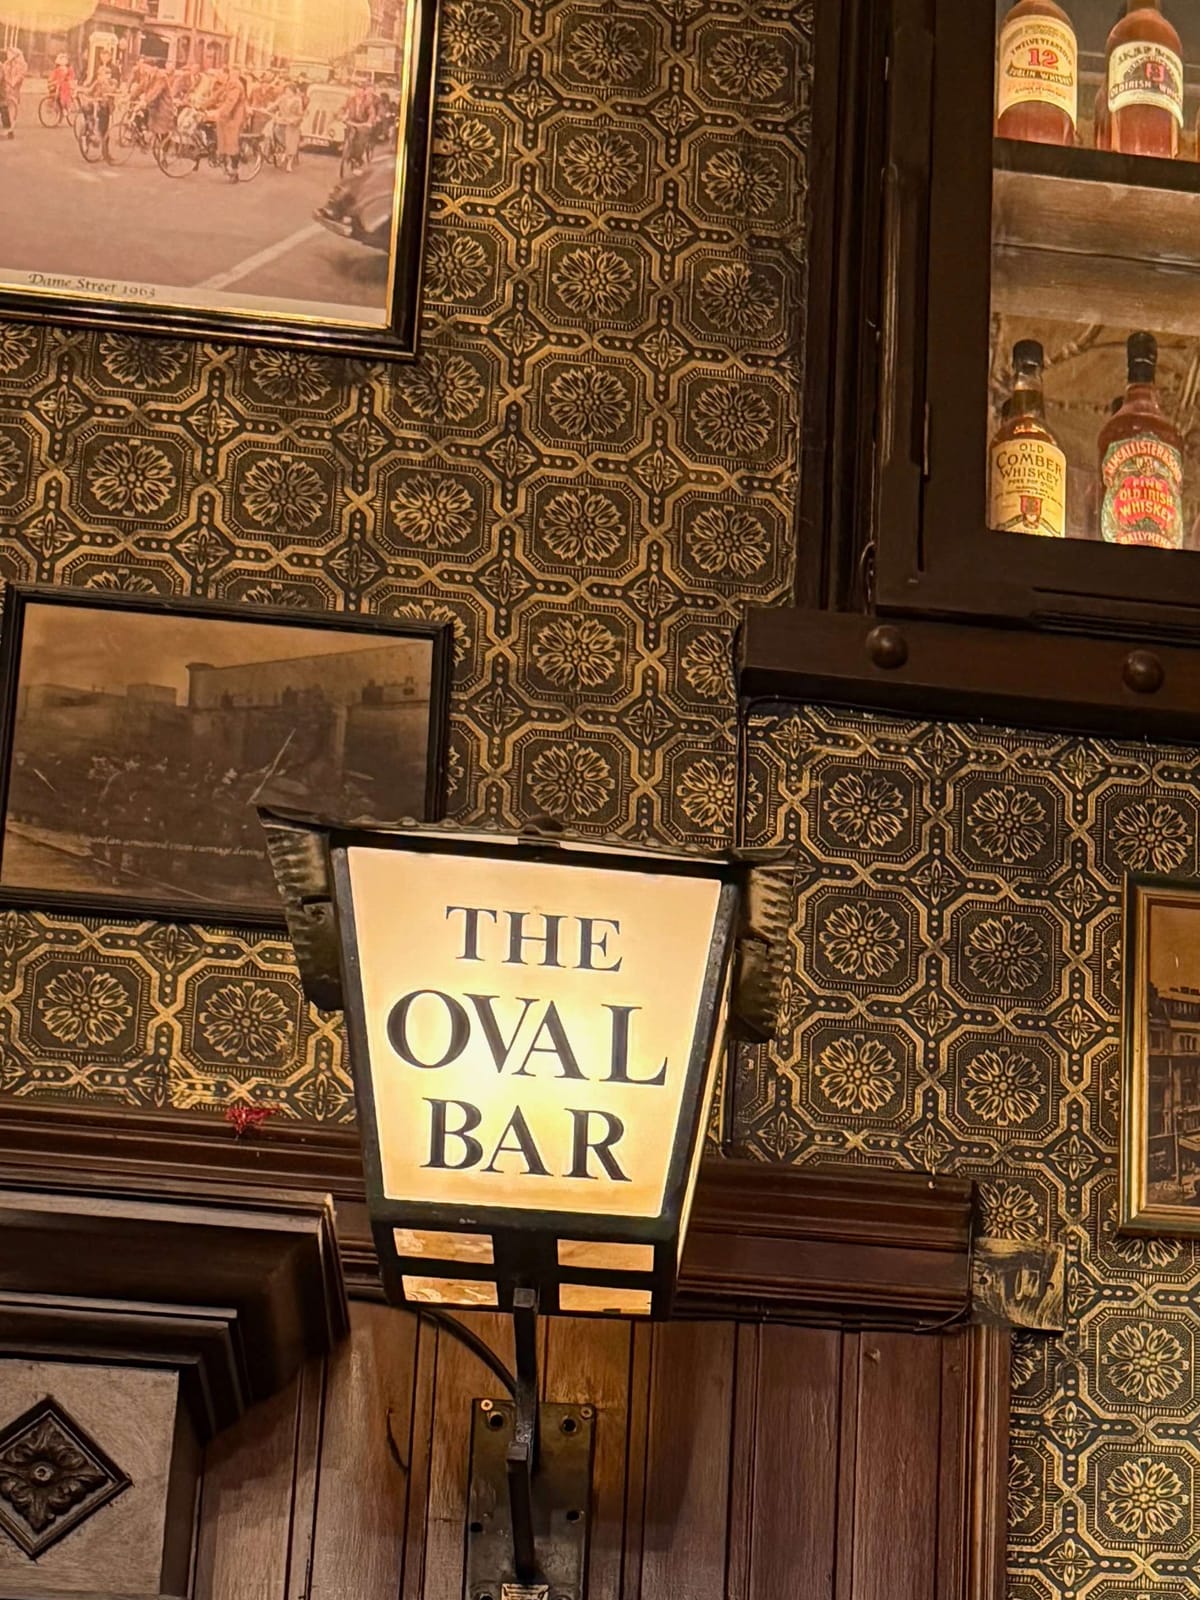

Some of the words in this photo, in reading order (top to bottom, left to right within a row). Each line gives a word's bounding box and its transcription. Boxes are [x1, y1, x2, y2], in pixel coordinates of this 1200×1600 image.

[1028, 48, 1059, 70] 12
[28, 272, 71, 289] Dame
[75, 277, 117, 294] Street
[1019, 442, 1045, 454] OLD
[1120, 501, 1172, 521] WHISKEY
[446, 905, 623, 972] THE
[387, 989, 668, 1087] OVAL
[419, 1097, 632, 1182] BAR
